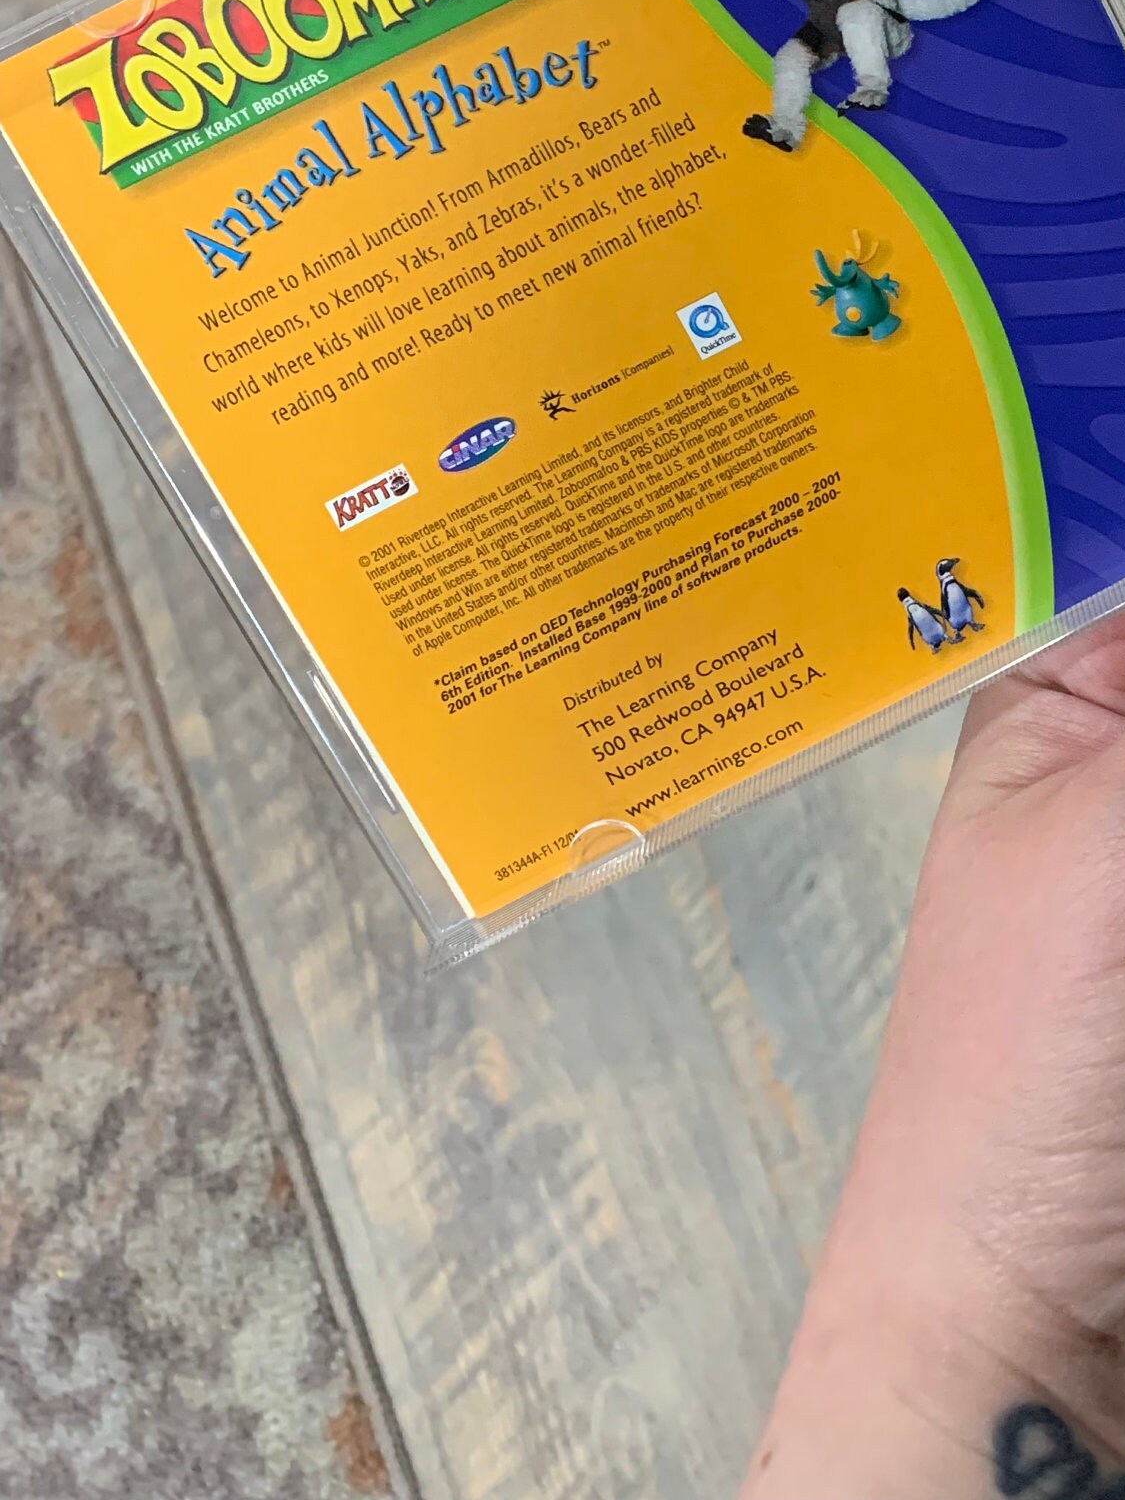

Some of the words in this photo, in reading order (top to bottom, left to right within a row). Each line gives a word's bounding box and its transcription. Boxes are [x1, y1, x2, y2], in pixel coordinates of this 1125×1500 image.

[130, 147, 174, 176] WITH
[171, 131, 205, 155] THE
[203, 106, 251, 141] KRATT
[251, 68, 330, 116] BROTHERS
[183, 119, 361, 279] Animal
[197, 284, 279, 332] Welcome
[277, 274, 300, 293] to
[300, 237, 362, 283] Animal
[361, 199, 439, 252] Junction!
[436, 180, 485, 212] From
[485, 134, 581, 189] Armadillos,
[577, 108, 628, 141] Bears
[628, 86, 662, 117] and
[203, 314, 311, 373] Chameleons,
[309, 301, 331, 320] to
[327, 268, 399, 310] Xenops,
[395, 246, 445, 274] Yaks,
[444, 220, 479, 252] and
[477, 196, 542, 235] Zebras,
[571, 172, 585, 188] a
[584, 111, 697, 181] wonder-filled
[210, 374, 262, 413] world
[261, 351, 316, 387] where
[312, 331, 352, 360] kids
[351, 310, 386, 341] will
[383, 296, 425, 325] love
[421, 260, 496, 306] learning
[495, 232, 547, 269] about
[545, 199, 617, 243] animals,
[616, 183, 648, 206] the
[648, 143, 727, 191] alphabet,
[270, 383, 338, 426] reading
[336, 360, 371, 392] and
[370, 335, 422, 374] more!
[418, 312, 473, 349] Ready
[473, 302, 495, 321] to
[495, 277, 542, 311] meet
[541, 258, 578, 288] new
[579, 224, 638, 268] animal
[636, 191, 703, 238] friends?
[700, 332, 737, 354] QuickTime
[572, 374, 621, 405] Horizons
[333, 478, 390, 528] KRATT
[369, 541, 398, 563] 2001
[396, 517, 448, 549] Riverdeep
[445, 491, 499, 523] Interactive
[496, 468, 543, 497] Learning
[540, 446, 584, 475] Limited,
[581, 435, 603, 454] and
[600, 430, 617, 444] its
[614, 406, 665, 436] licensors,
[663, 392, 685, 411] and
[682, 373, 723, 401] Brighter
[722, 358, 750, 380] Child
[440, 684, 463, 702] 6th
[464, 661, 514, 691] Edition.
[518, 625, 574, 663] Installed
[574, 611, 607, 634] Base
[608, 575, 672, 615] 1999-2000
[674, 560, 700, 582] and
[700, 547, 730, 568] Plan
[730, 539, 745, 552] to
[746, 507, 805, 544] Purchase
[447, 691, 478, 715] 2001
[479, 682, 498, 698] for
[496, 670, 524, 688] The
[524, 640, 581, 675] Learning
[581, 607, 642, 645] Company
[643, 594, 669, 613] line
[670, 582, 684, 599] of
[686, 556, 742, 592] software
[743, 526, 803, 564] products.
[479, 638, 519, 667] based
[520, 631, 538, 646] on
[539, 613, 569, 636] QED
[567, 578, 640, 621] Technology
[641, 540, 713, 583] Purchasing
[712, 510, 768, 546] Forecast
[768, 492, 800, 517] 2000
[811, 470, 841, 494] 2001
[562, 659, 643, 712] Distributed
[644, 652, 663, 670] by
[575, 715, 616, 738] The
[615, 673, 696, 720] Learning
[694, 628, 777, 677] Company
[591, 735, 627, 763] 500
[628, 688, 715, 744] Redwood
[714, 642, 805, 699] Boulevard
[604, 745, 680, 786] Novato,
[680, 723, 714, 746] CA
[713, 690, 765, 729] 94947
[769, 666, 827, 699] U.S.A.
[624, 720, 804, 818] www.learningco.com
